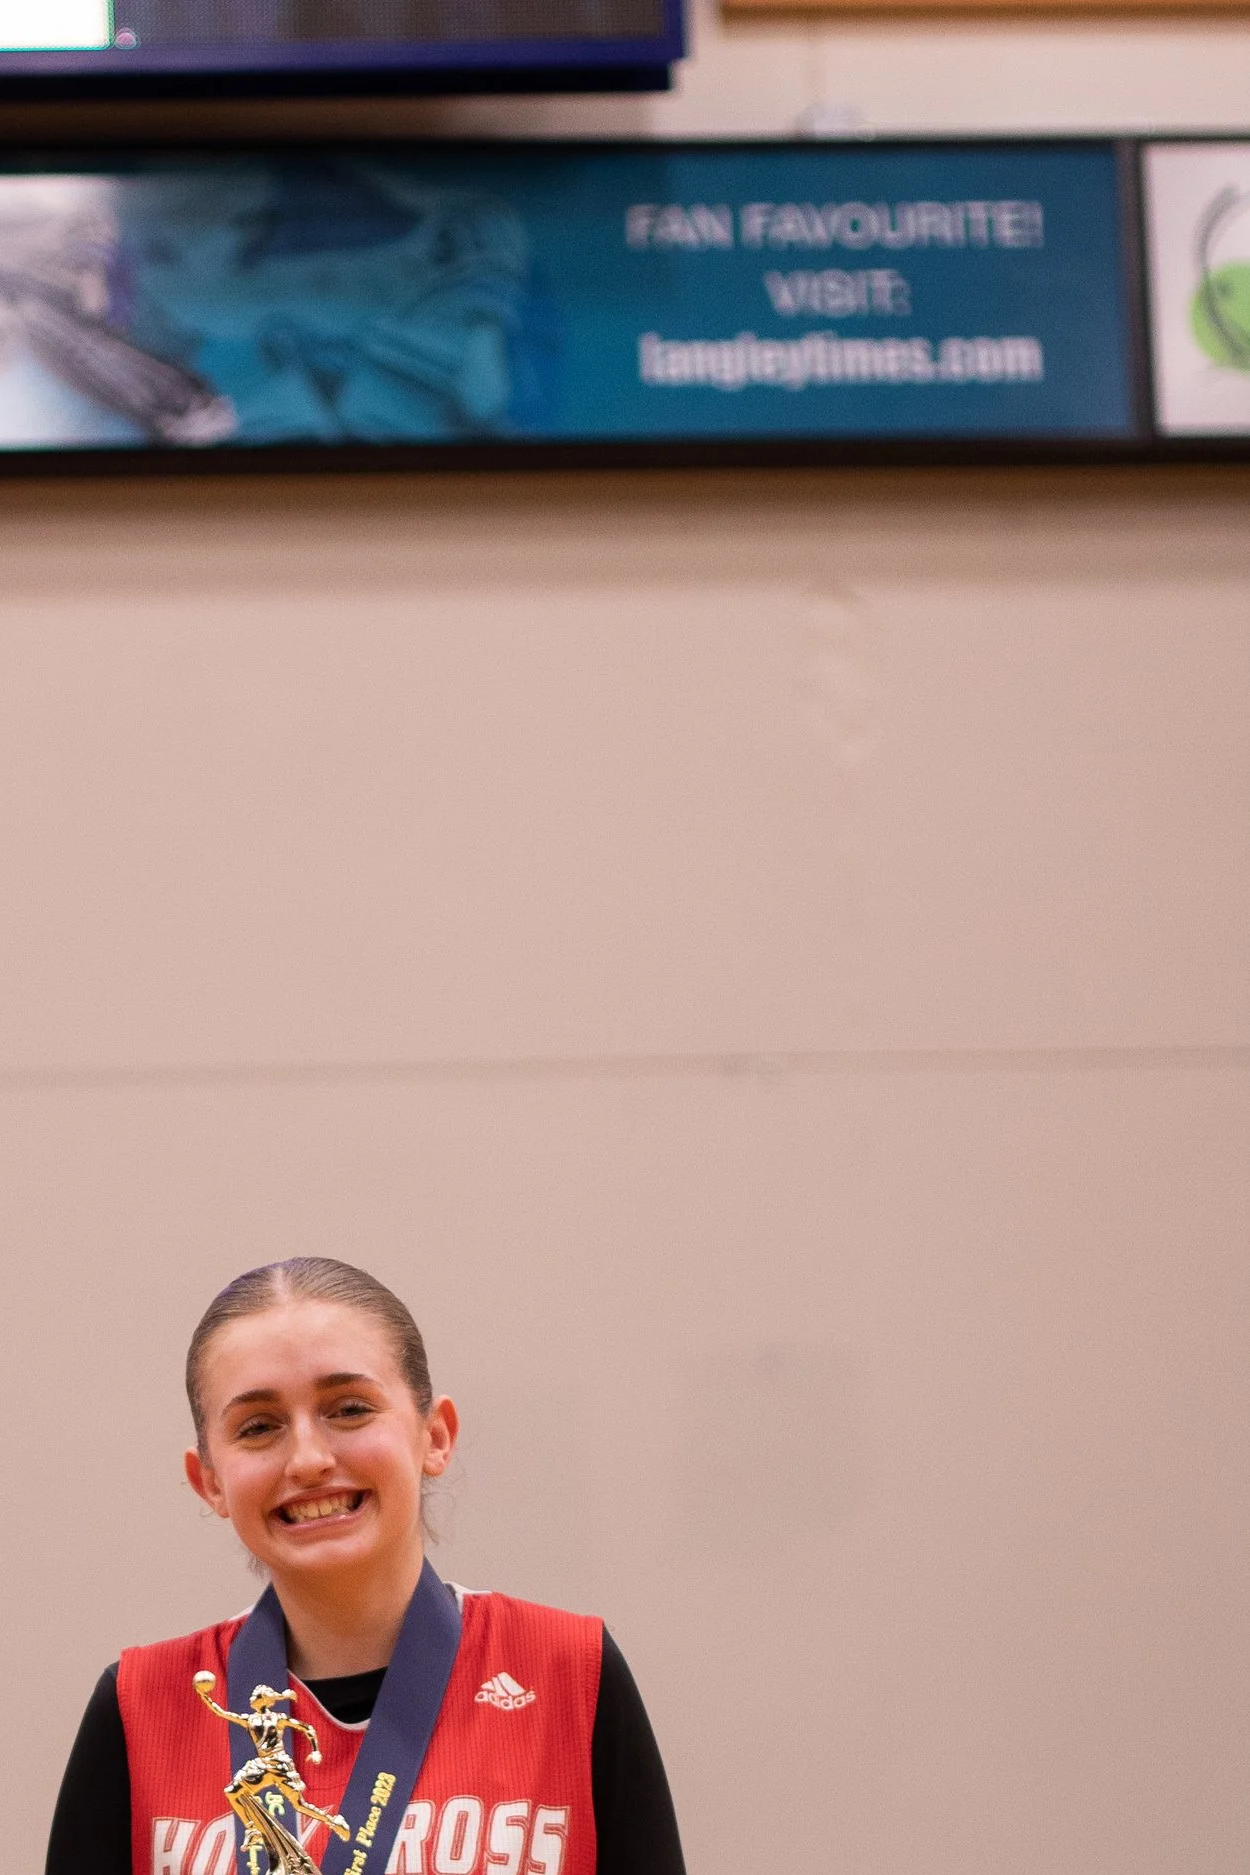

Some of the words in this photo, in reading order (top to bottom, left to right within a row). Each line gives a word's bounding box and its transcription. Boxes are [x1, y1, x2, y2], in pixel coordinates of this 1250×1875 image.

[626, 203, 734, 250] FAN
[741, 202, 1043, 250] FAVOURITE!
[638, 331, 1043, 391] langleytimes.com
[473, 1689, 536, 1711] adidas
[355, 1805, 382, 1848] Place
[370, 1771, 397, 1807] 2023
